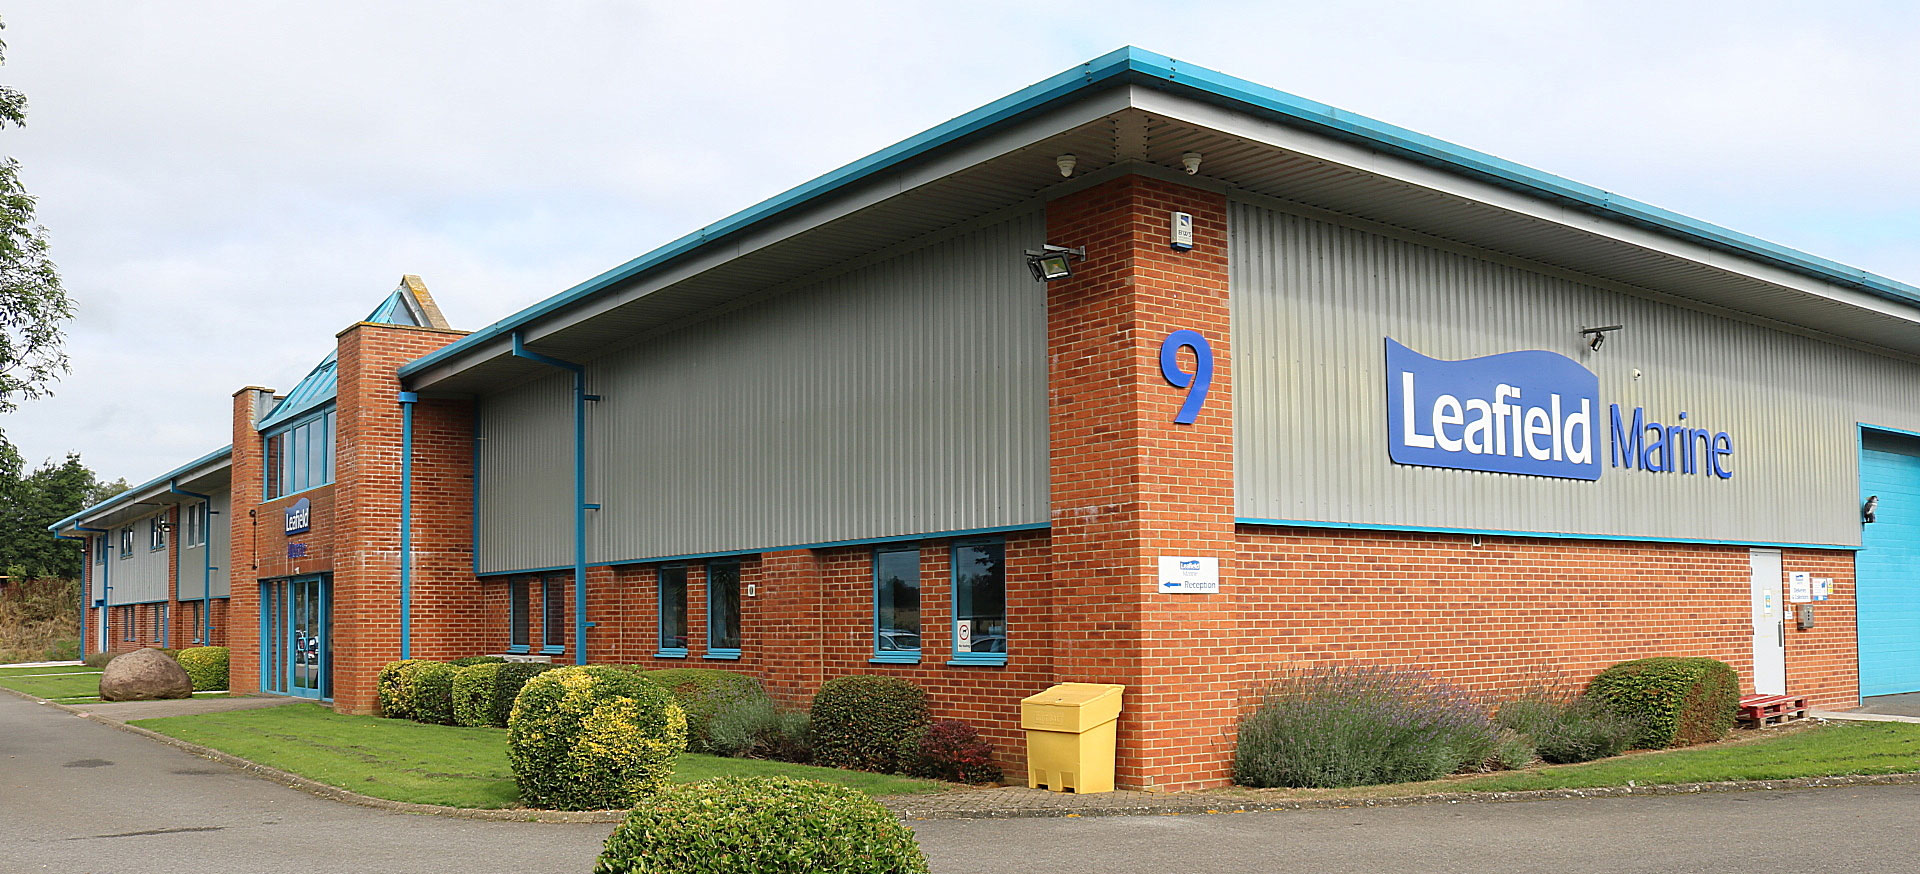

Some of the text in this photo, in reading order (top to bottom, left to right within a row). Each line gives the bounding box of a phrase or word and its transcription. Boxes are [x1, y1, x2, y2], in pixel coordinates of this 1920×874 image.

[1160, 329, 1213, 424] 9
[1402, 371, 1733, 479] Leafield Marine
[286, 507, 309, 531] Leafield
[1184, 581, 1216, 591] Reception
